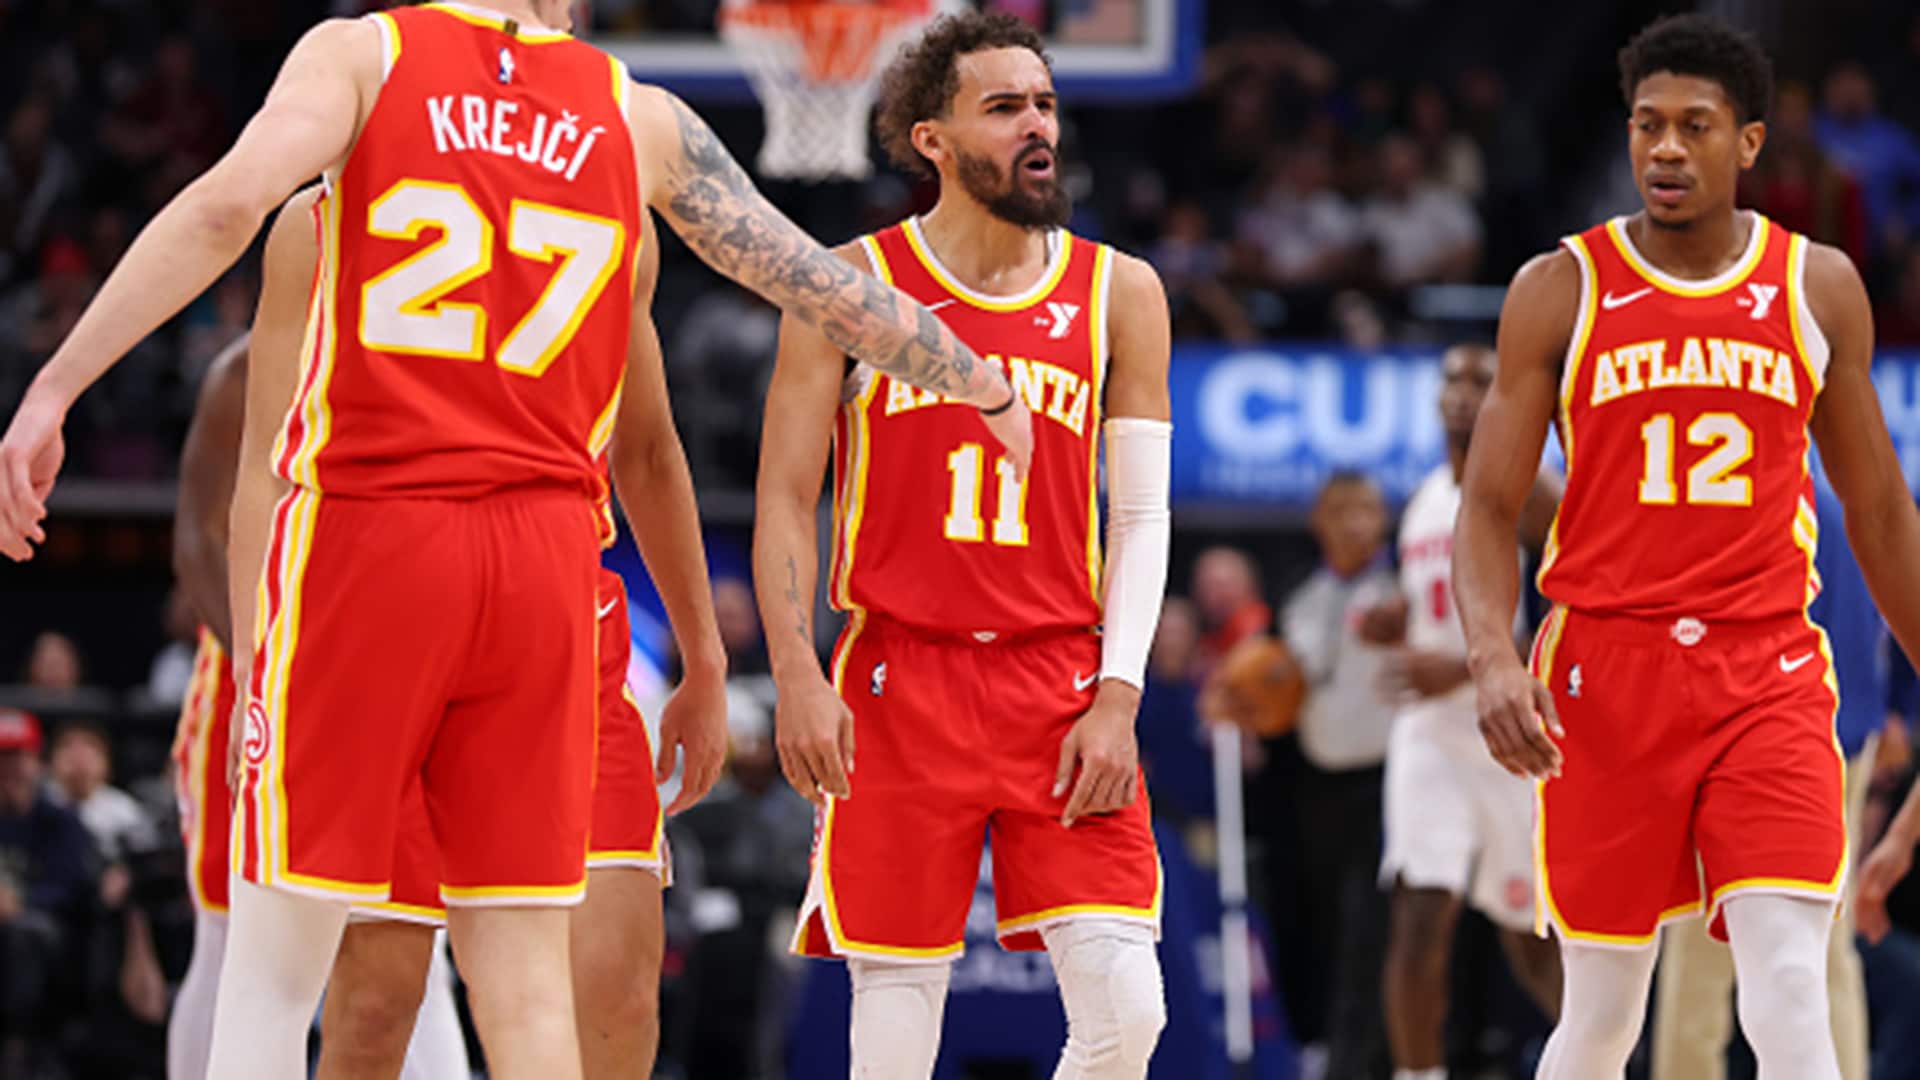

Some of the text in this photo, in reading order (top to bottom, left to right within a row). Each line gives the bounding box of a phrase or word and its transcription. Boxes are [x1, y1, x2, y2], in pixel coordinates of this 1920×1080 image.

[427, 95, 607, 181] KREJČÍ
[359, 178, 625, 378] 27
[885, 353, 1091, 438] ANTA
[1589, 336, 1798, 408] ATLANTA
[943, 441, 1030, 547] 11
[1637, 411, 1754, 507] 12
